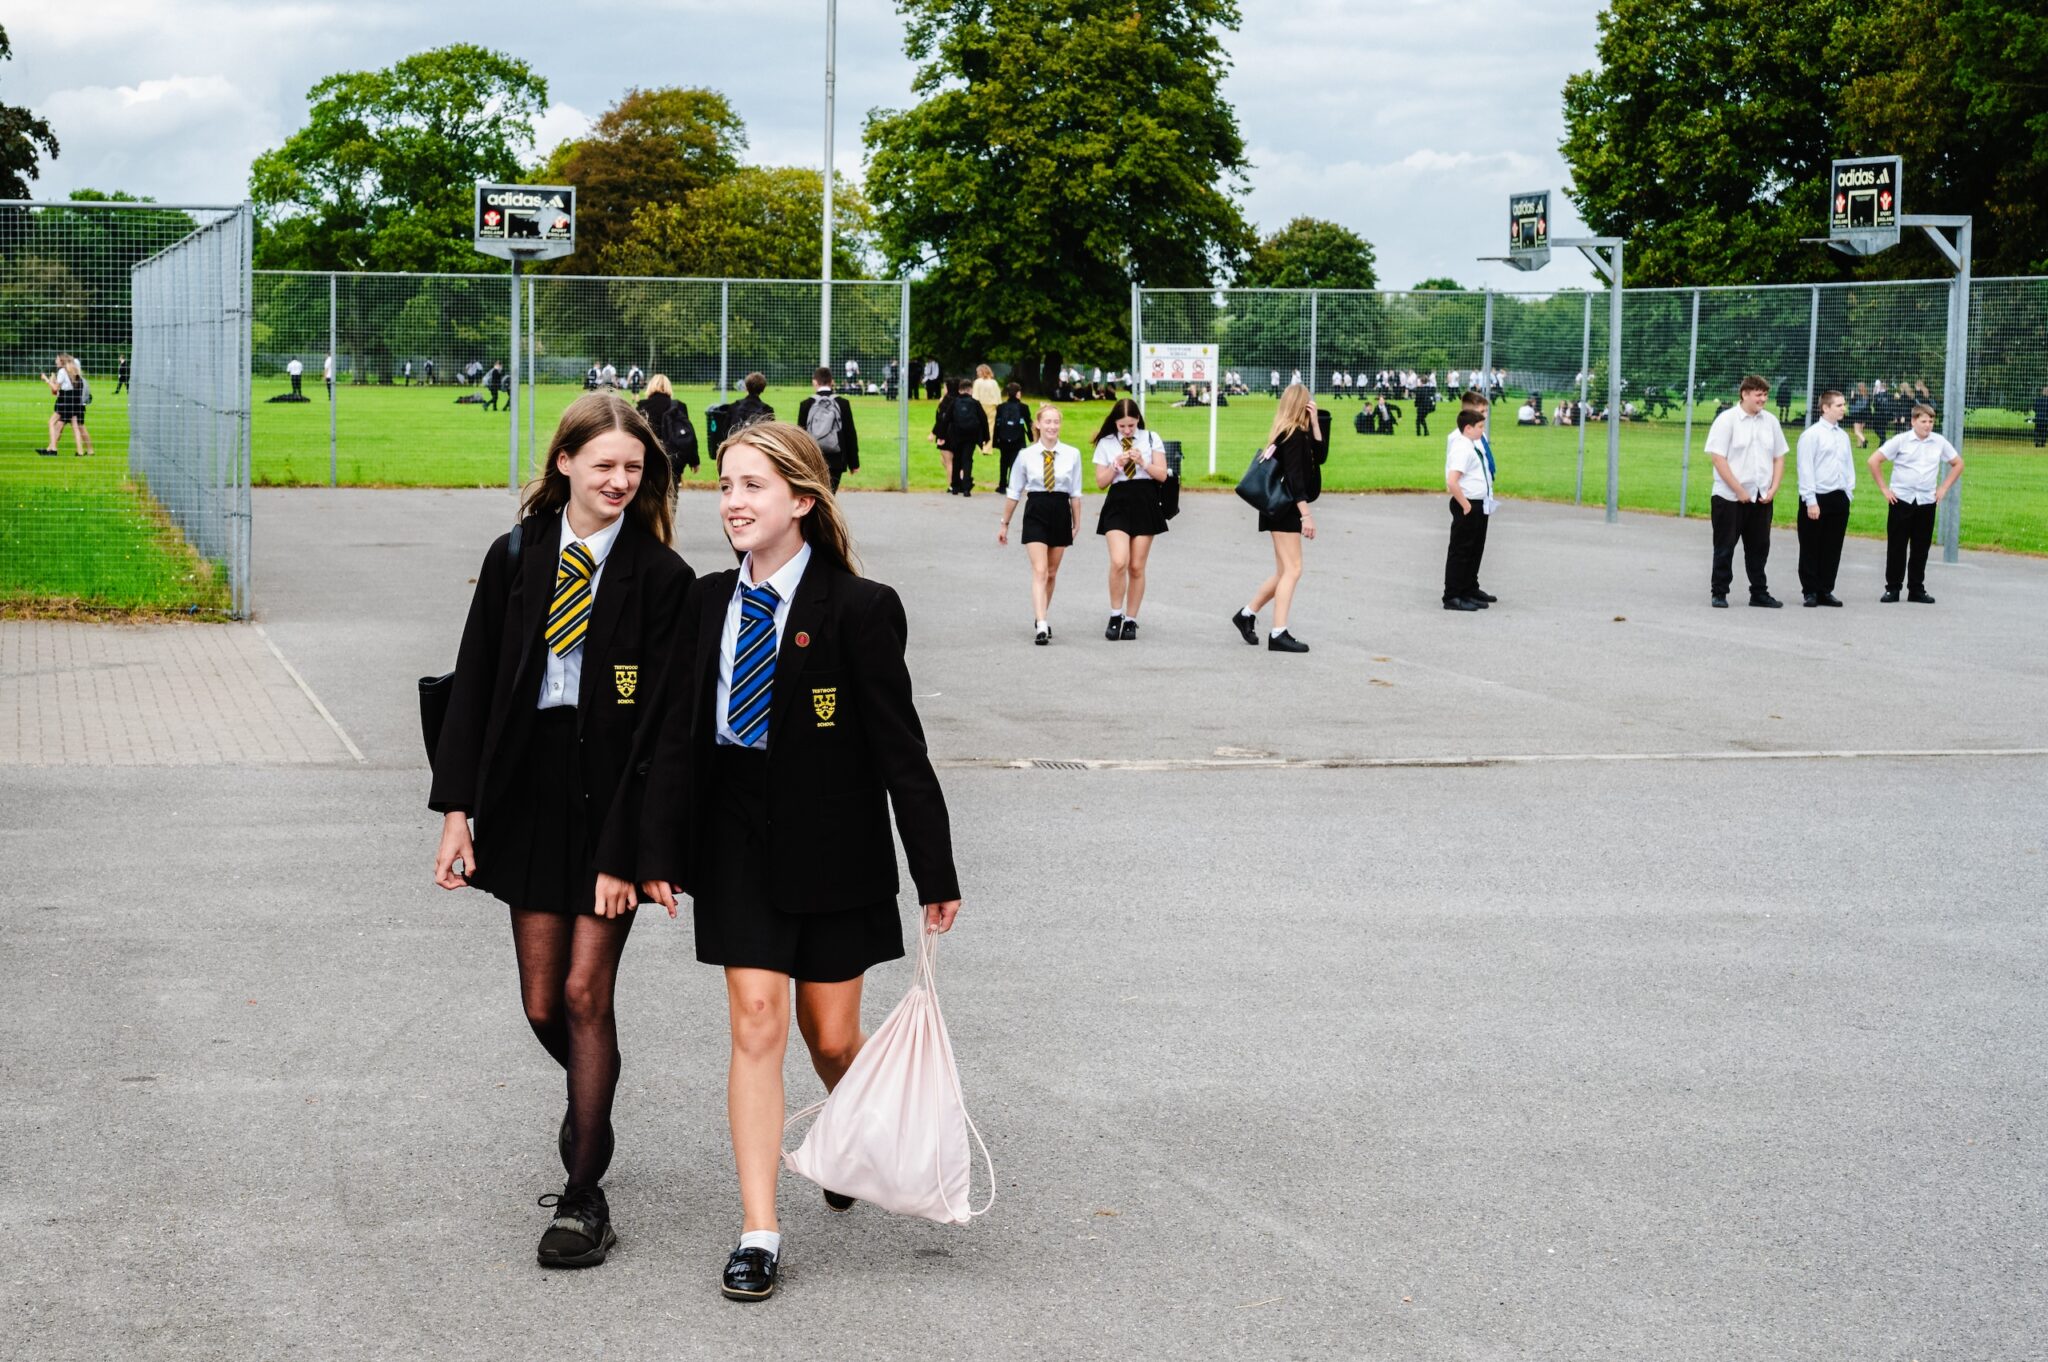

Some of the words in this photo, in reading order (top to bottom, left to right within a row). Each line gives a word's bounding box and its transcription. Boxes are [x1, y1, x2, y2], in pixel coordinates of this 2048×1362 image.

[1838, 168, 1875, 187] adidas
[487, 192, 542, 207] adidas
[1513, 200, 1535, 216] adidas
